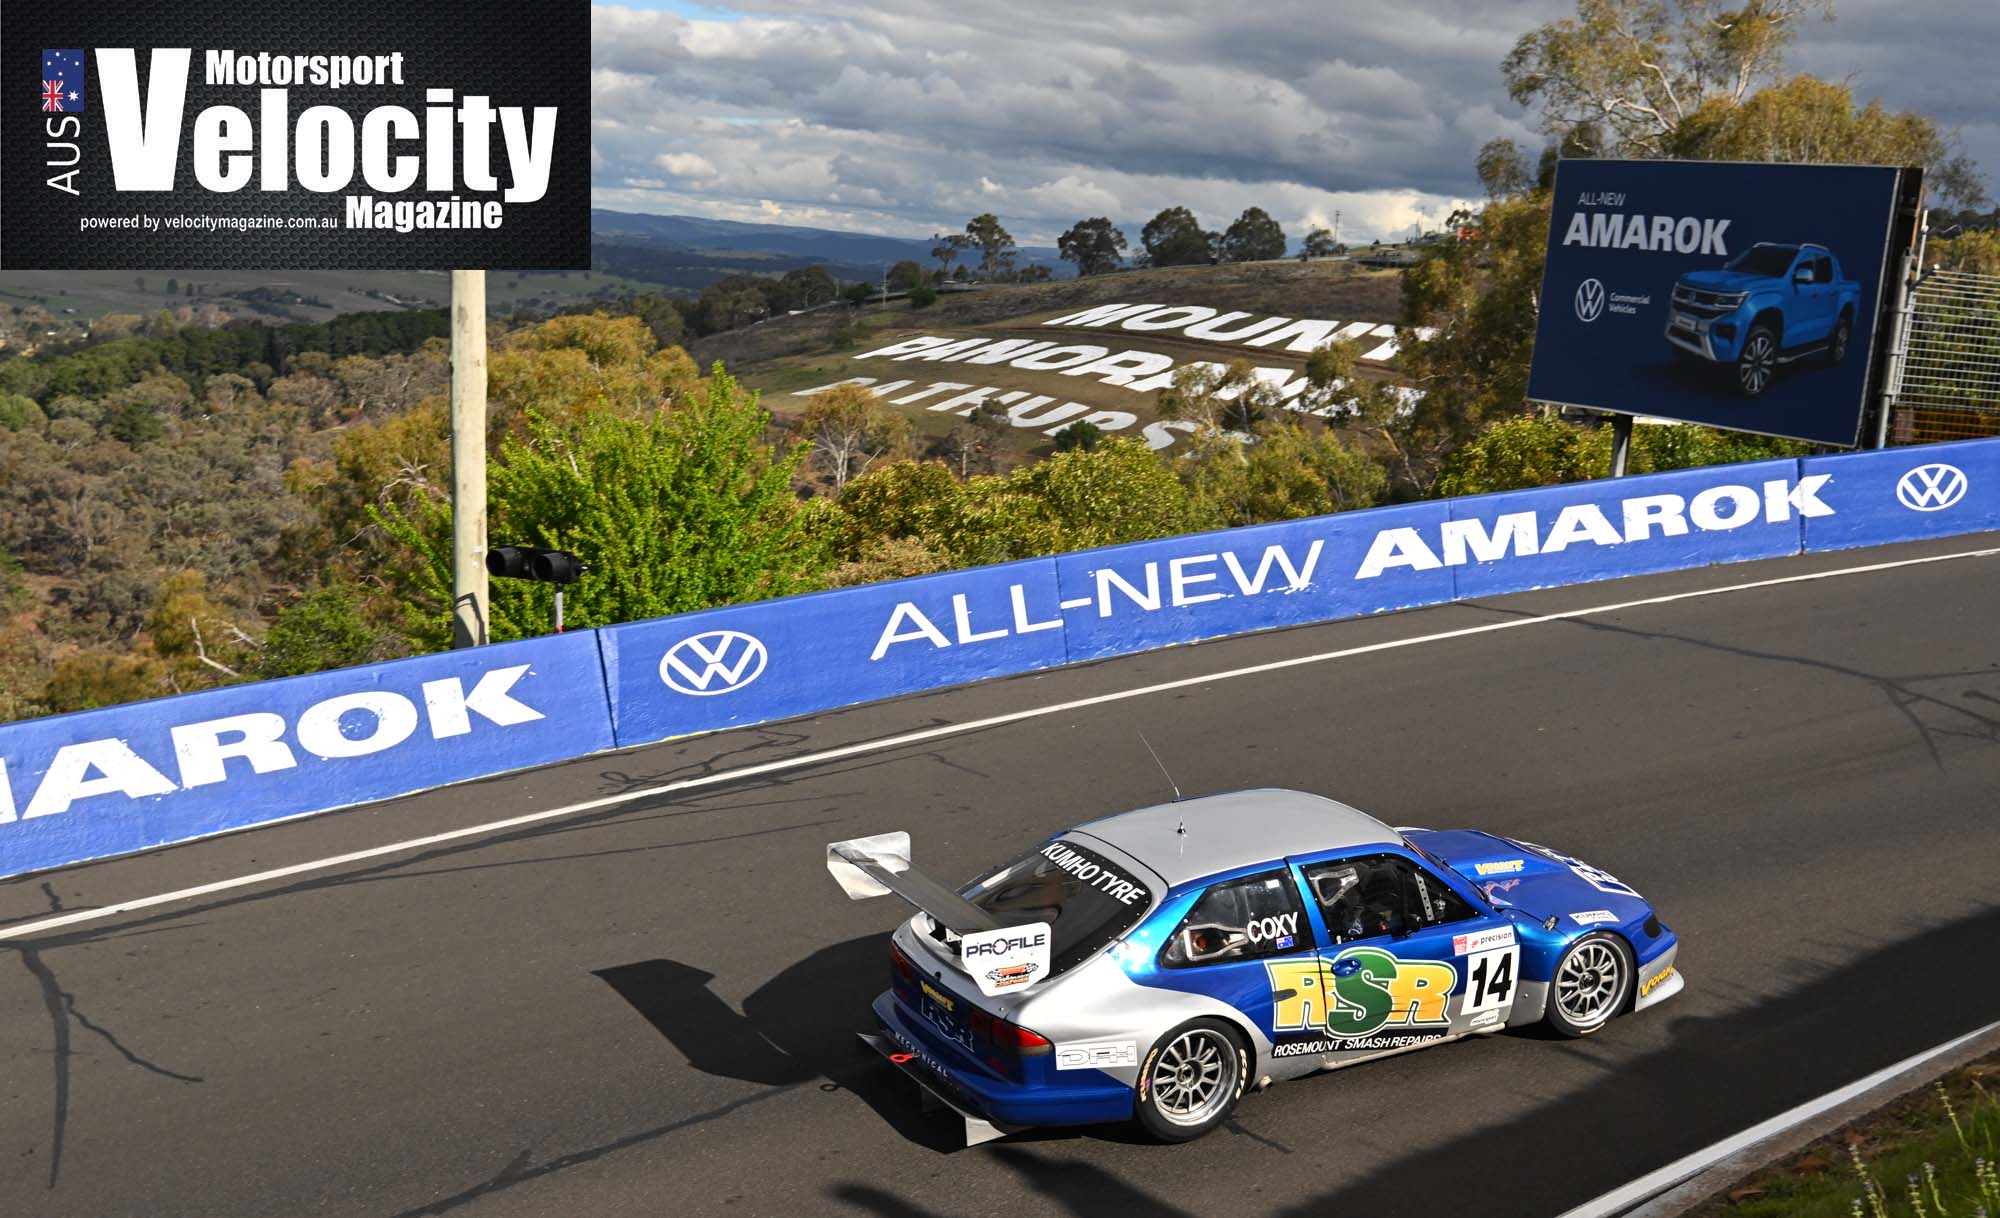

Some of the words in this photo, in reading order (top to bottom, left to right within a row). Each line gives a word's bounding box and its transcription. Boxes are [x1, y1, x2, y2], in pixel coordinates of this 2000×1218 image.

[1577, 192, 1626, 207] ALL-NEW
[1563, 212, 1732, 256] AMAROK
[1041, 303, 1442, 361] MOUNT
[870, 539, 1325, 661] ALL-NEW
[1354, 473, 1836, 580] AMAROK
[0, 664, 546, 823] AROK
[1040, 842, 1101, 881] KUMHO
[1091, 870, 1146, 905] TYRE
[966, 934, 1045, 959] PROFILE
[1247, 911, 1298, 943] COXY
[1480, 932, 1512, 945] precision
[1263, 946, 1458, 1041] RSR
[1472, 952, 1512, 1008] 14
[1273, 1039, 1342, 1057] ROSEMOUNT
[1344, 1036, 1391, 1050] SMASH
